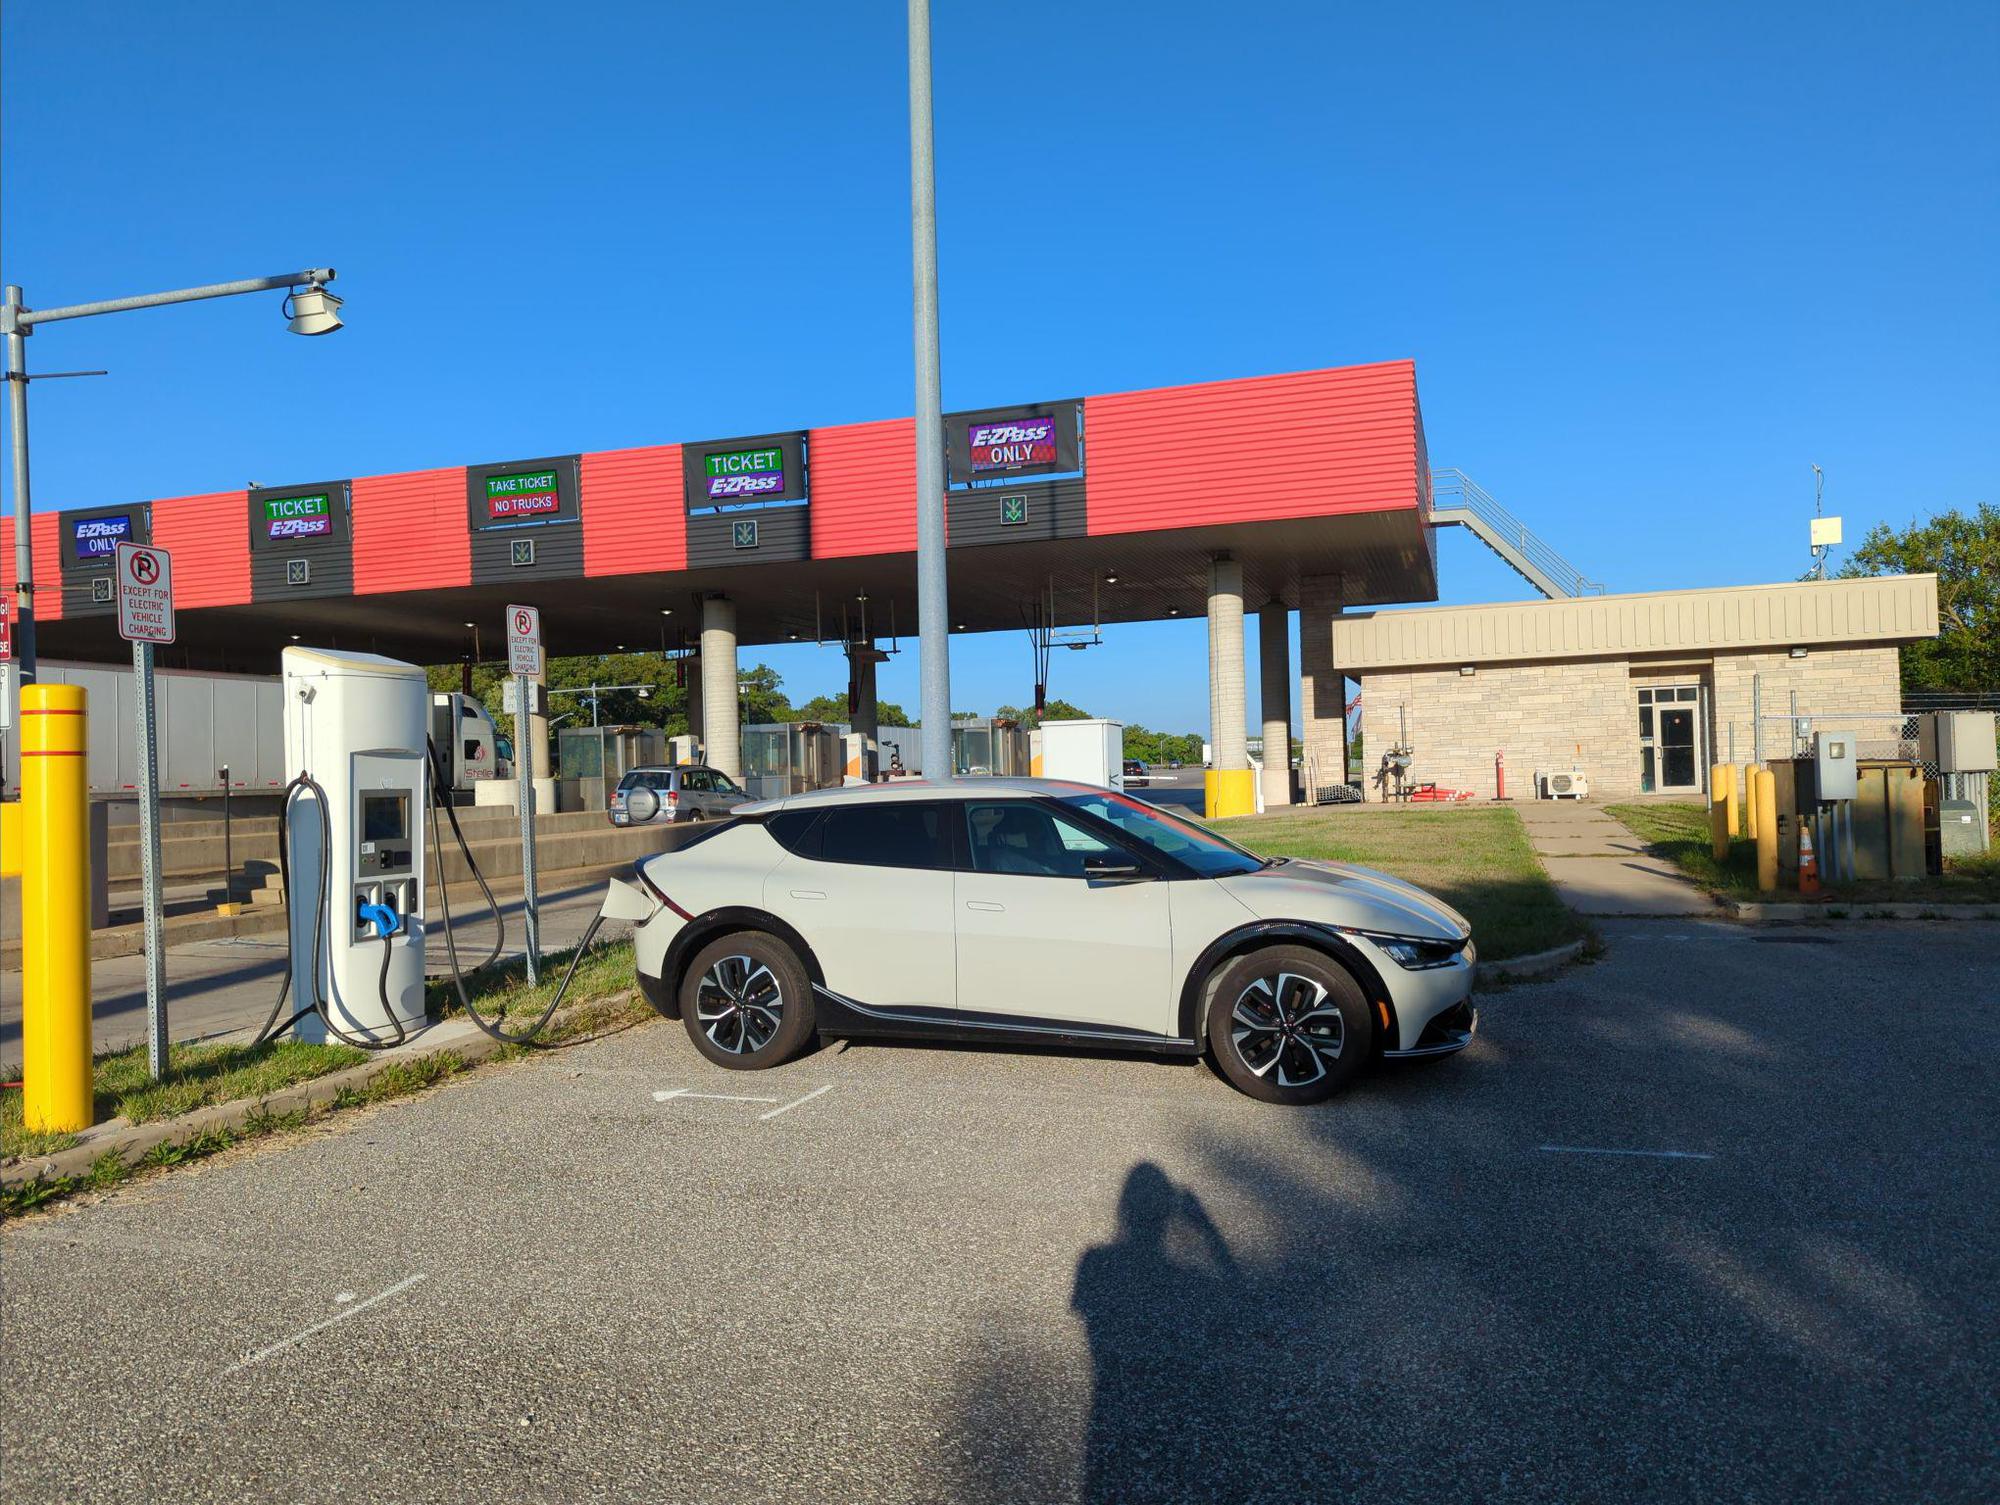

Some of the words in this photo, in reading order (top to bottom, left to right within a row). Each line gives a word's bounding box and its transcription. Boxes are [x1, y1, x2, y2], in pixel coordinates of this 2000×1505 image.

[990, 443, 1033, 463] ONLY
[711, 451, 776, 473] TICKET
[489, 479, 517, 493] TAKE
[517, 475, 553, 489] TICKET
[270, 498, 323, 517] TICKET
[495, 500, 510, 512] NO
[511, 496, 552, 510] TRUCKS
[89, 537, 117, 552] ONLY
[123, 585, 152, 597] EXCEPT
[153, 589, 169, 600] FOR
[128, 598, 165, 612] ELECTRIC
[131, 611, 163, 624] VEHICLE
[128, 623, 167, 637] CHARGING
